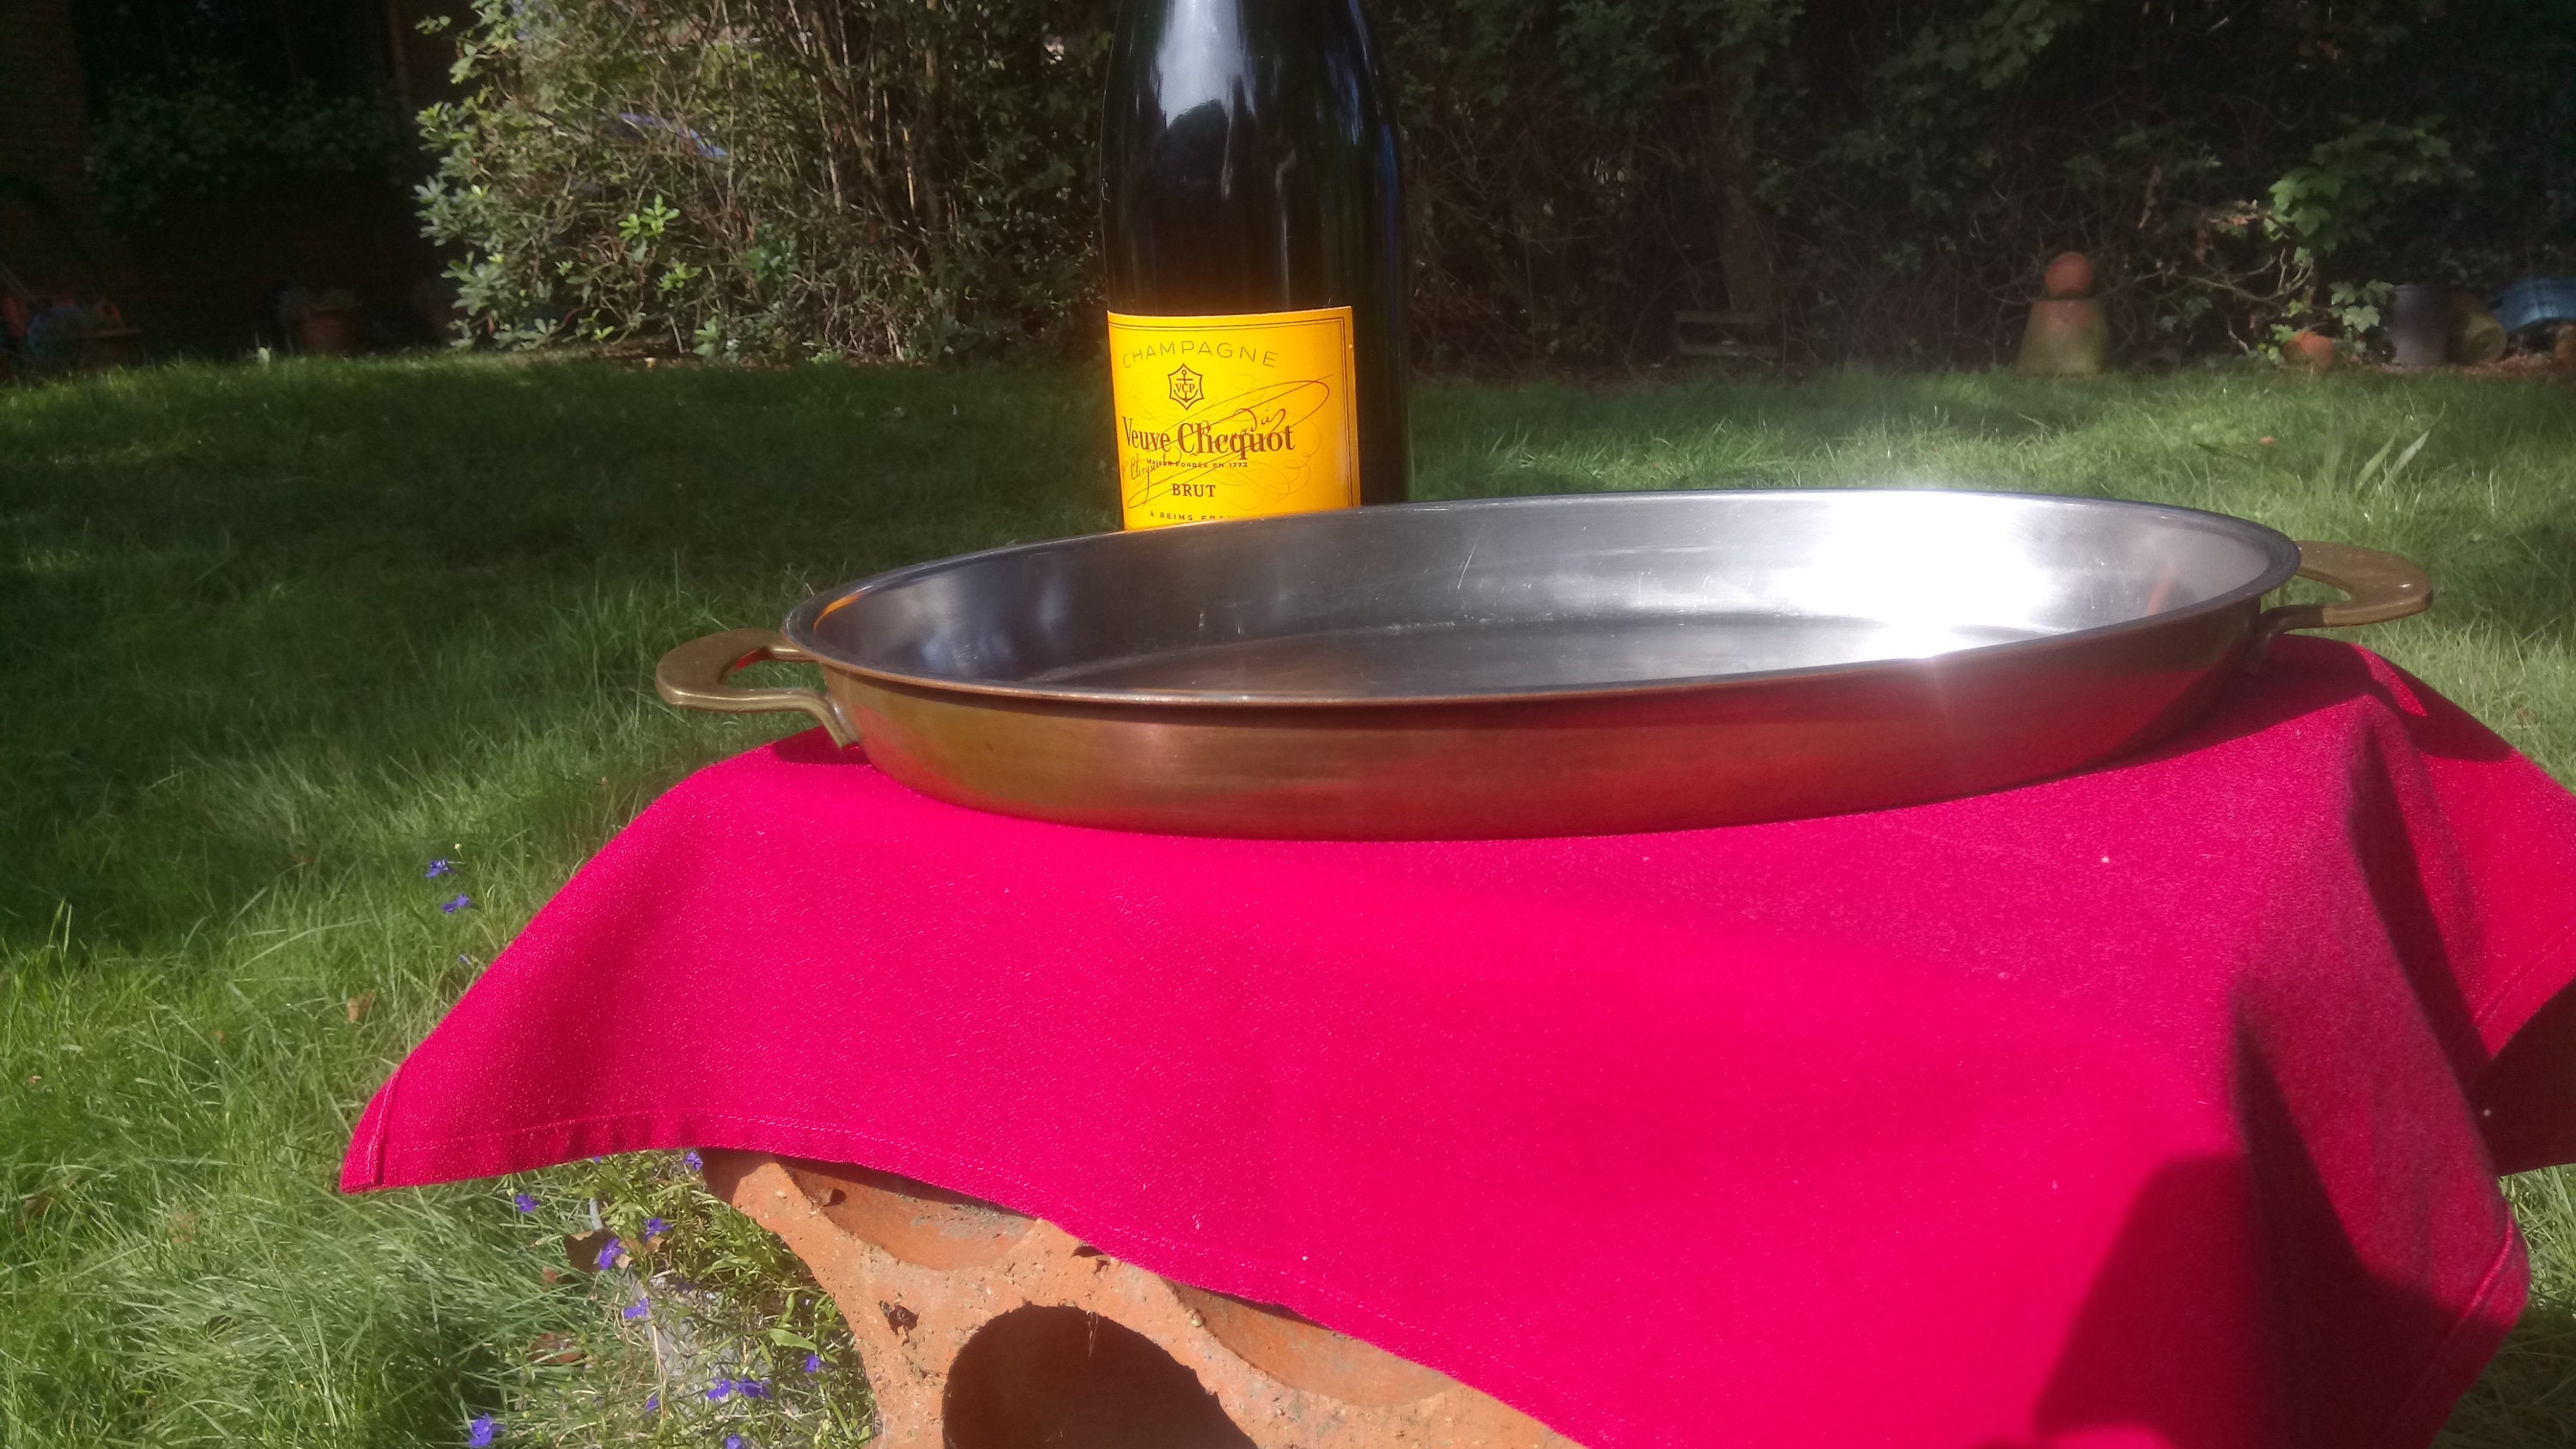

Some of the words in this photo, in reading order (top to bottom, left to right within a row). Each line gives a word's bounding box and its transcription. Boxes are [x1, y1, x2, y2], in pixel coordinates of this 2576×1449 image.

[1122, 340, 1279, 368] CHAMPAGNE
[1175, 383, 1196, 393] VCP
[1121, 415, 1171, 452] Veuve
[1177, 421, 1296, 460] Clicquot
[1171, 482, 1216, 497] BRUT
[1159, 512, 1193, 521] REIMS
